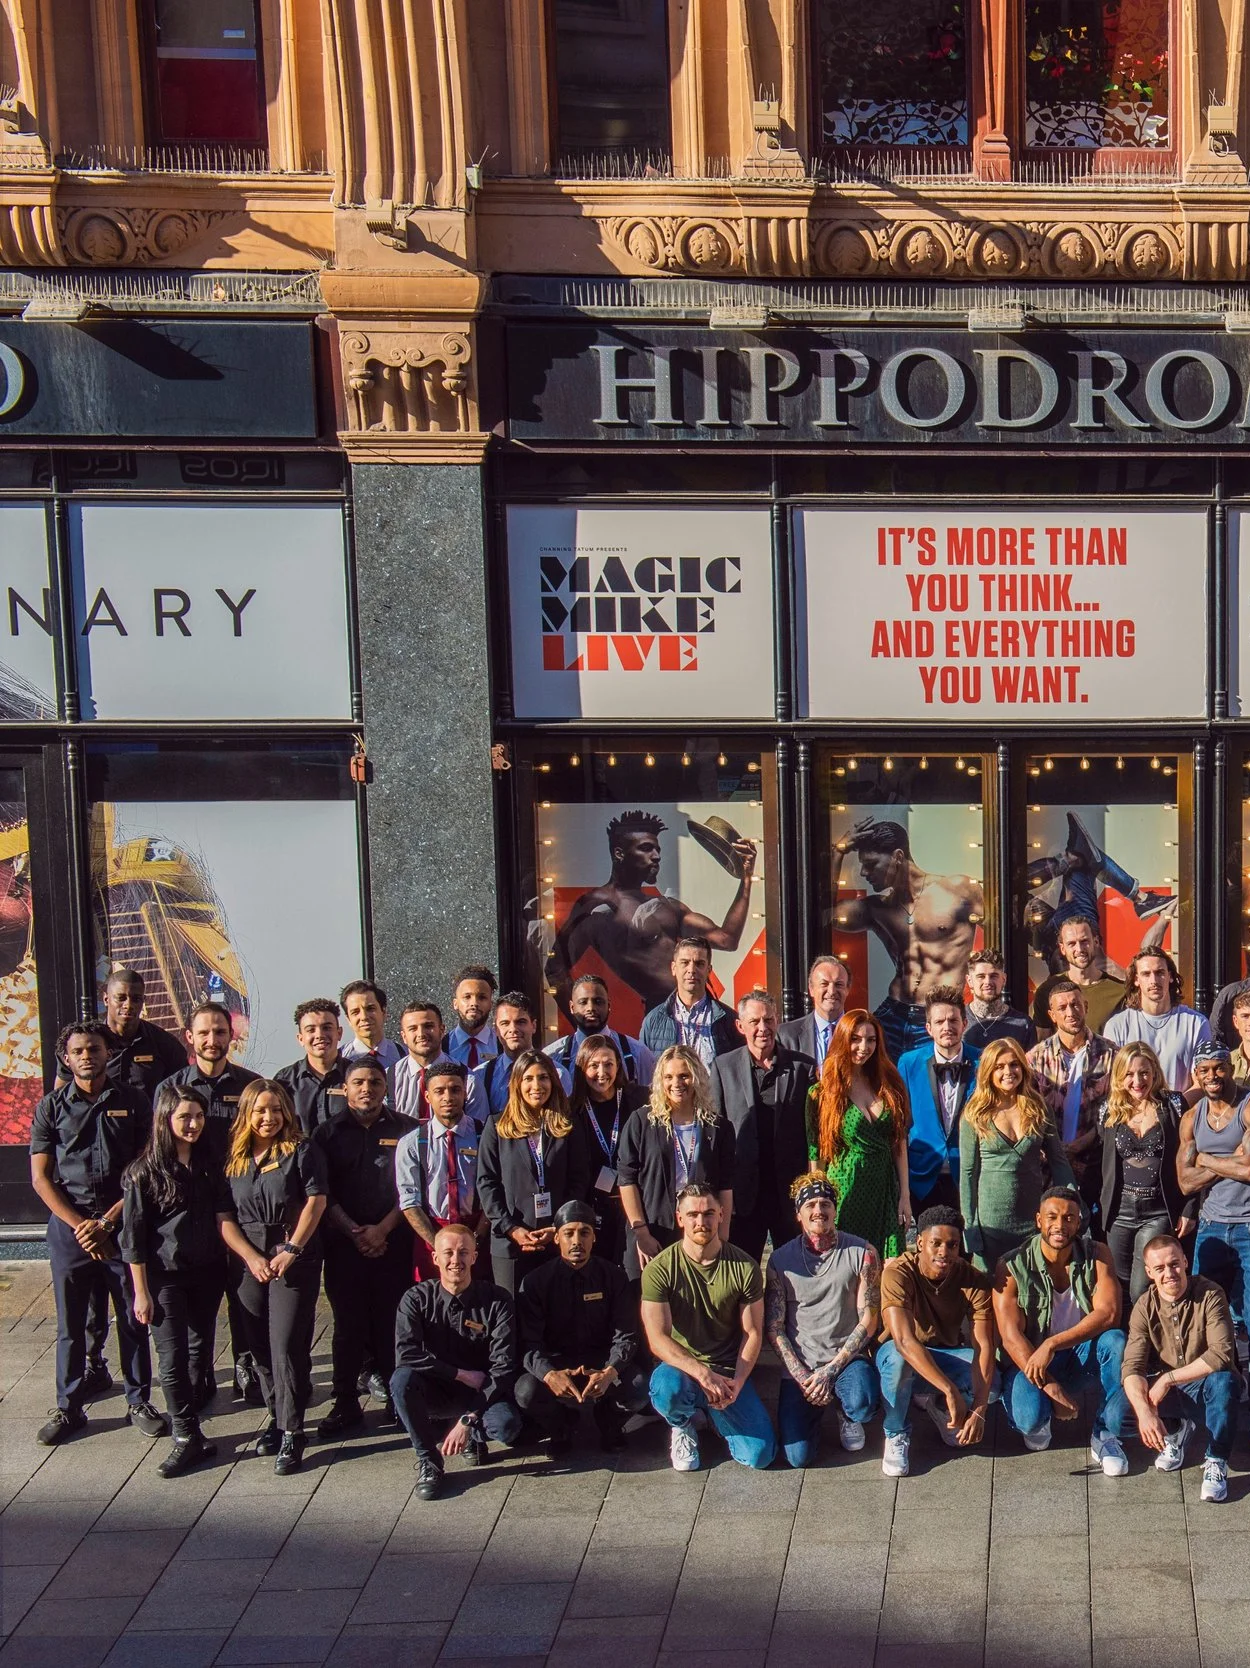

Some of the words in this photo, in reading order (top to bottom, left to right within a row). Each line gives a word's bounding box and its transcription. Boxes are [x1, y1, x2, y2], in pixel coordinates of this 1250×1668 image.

[877, 527, 937, 566] IT'S
[947, 527, 1036, 566] MORE
[1045, 527, 1127, 566] THAN
[540, 556, 742, 593] MAGIC
[905, 573, 969, 612] YOU
[979, 573, 1100, 612] THINK...
[540, 596, 716, 633] MIKE
[542, 635, 698, 671] LIVE
[871, 620, 935, 658] AND
[945, 619, 1136, 658] EVERYTHING
[919, 665, 982, 704] YOU
[991, 665, 1089, 704] WANT.
